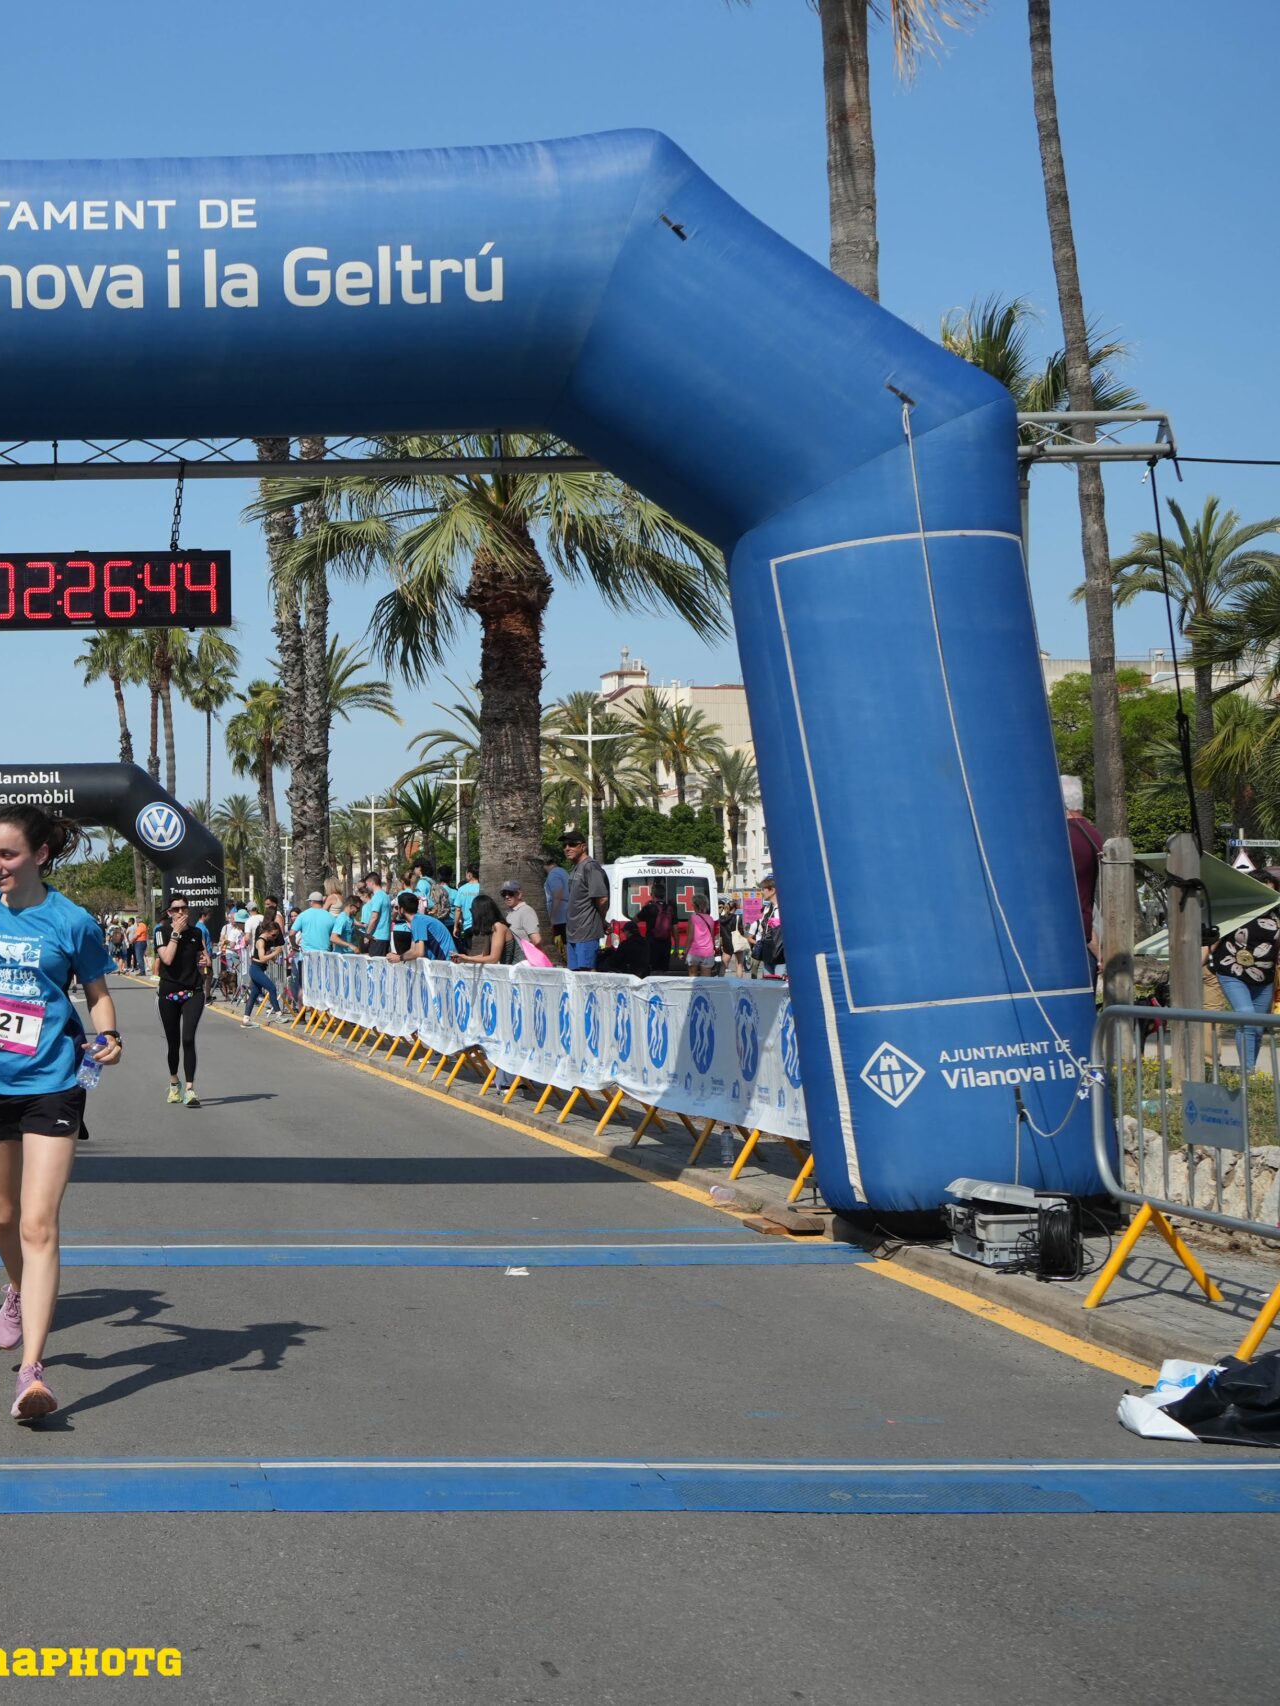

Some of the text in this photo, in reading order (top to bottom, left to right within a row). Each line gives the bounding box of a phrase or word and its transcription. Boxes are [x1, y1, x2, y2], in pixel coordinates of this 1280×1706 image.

[198, 198, 258, 230] DE
[166, 248, 181, 308] i
[203, 248, 259, 308] la
[283, 241, 504, 307] Geltrú
[176, 875, 217, 884] Vilamòbil
[939, 1039, 1072, 1064] AJUNTAMENT DE
[940, 1064, 1046, 1090] Vilanova
[1048, 1060, 1057, 1081] i
[1058, 1059, 1076, 1080] la
